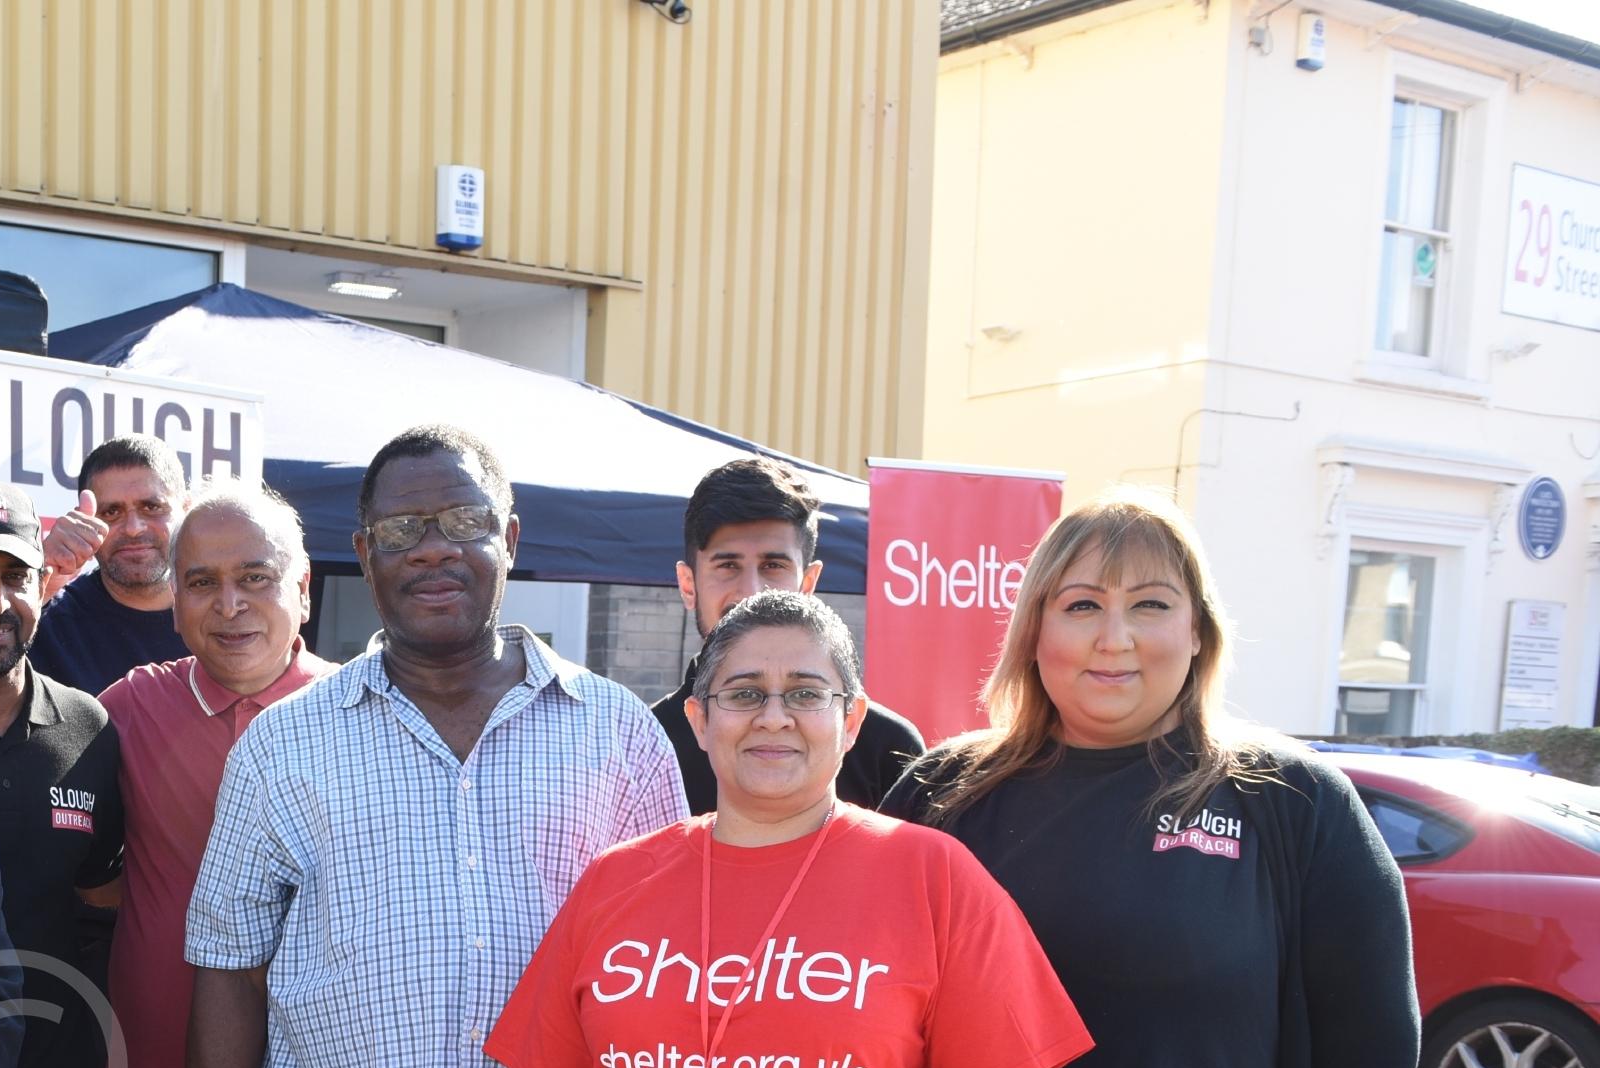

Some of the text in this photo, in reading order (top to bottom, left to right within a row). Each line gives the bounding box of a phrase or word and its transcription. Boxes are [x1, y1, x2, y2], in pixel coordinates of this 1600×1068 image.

[1515, 200, 1552, 287] 29
[883, 539, 1026, 610] Shelte
[50, 786, 95, 813] SLOUGH
[55, 812, 92, 829] OUTREACH
[1159, 832, 1234, 854] OUTREACH
[591, 936, 889, 1010] Shelter
